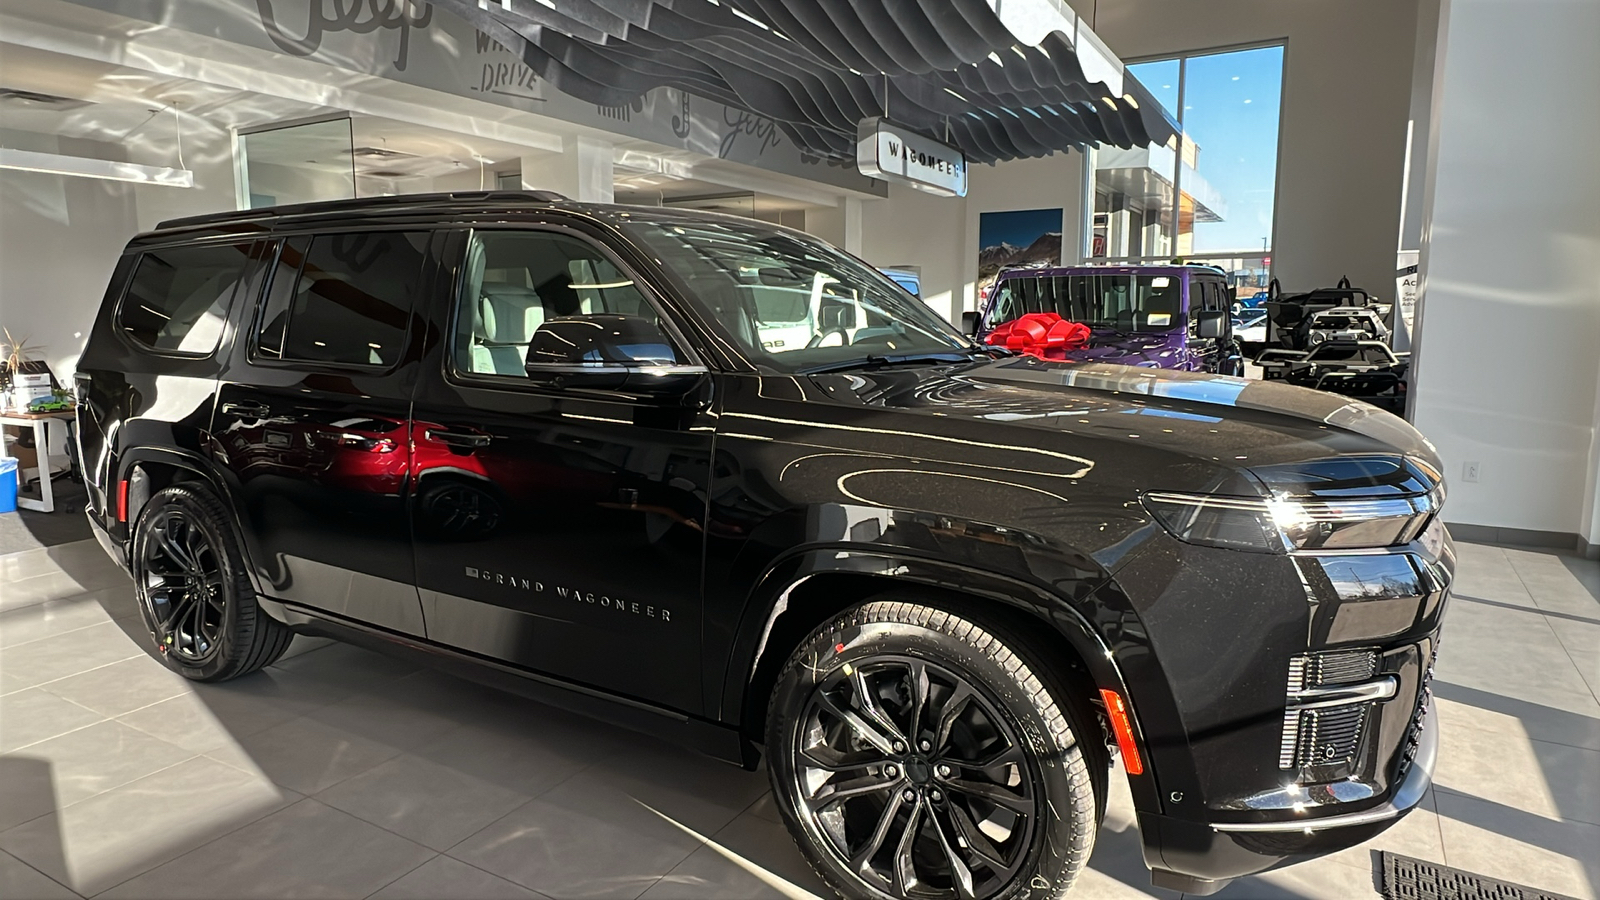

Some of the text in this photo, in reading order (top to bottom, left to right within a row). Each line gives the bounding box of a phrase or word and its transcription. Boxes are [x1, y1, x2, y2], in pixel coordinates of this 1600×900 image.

[481, 63, 539, 92] DRIVE
[888, 141, 960, 178] WAGONEER
[482, 570, 671, 622] GRAND WAGONEER
